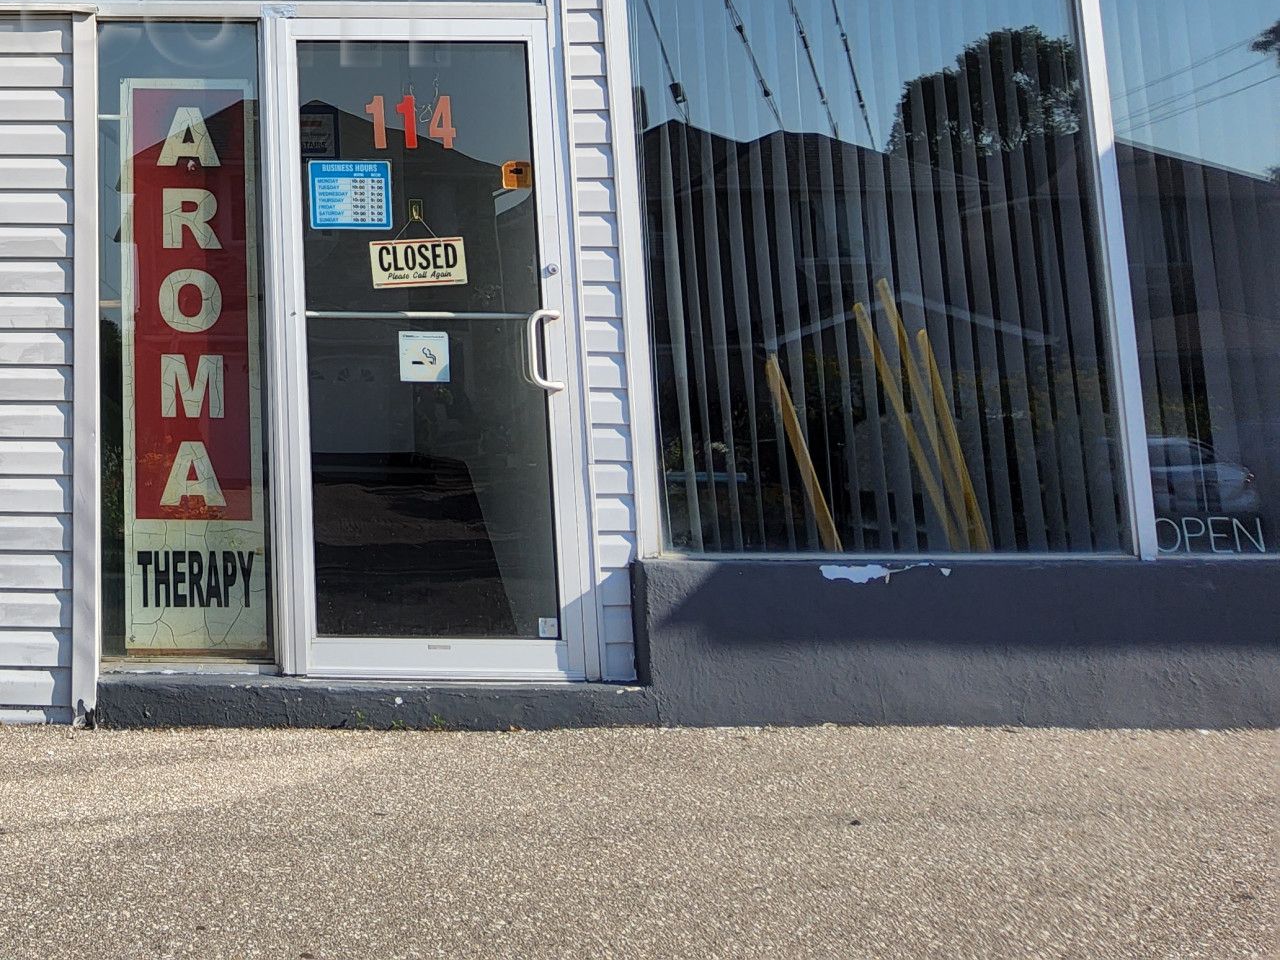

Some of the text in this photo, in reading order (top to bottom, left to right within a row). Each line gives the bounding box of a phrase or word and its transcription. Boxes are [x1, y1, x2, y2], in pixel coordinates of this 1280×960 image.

[365, 94, 458, 150] 114
[321, 163, 378, 173] BUSINESS HOURS
[378, 242, 458, 272] CLOSED
[387, 270, 452, 280] Please Call Again
[155, 106, 227, 508] AROMA
[1155, 517, 1266, 553] OPEN
[136, 549, 255, 609] THERAPY
